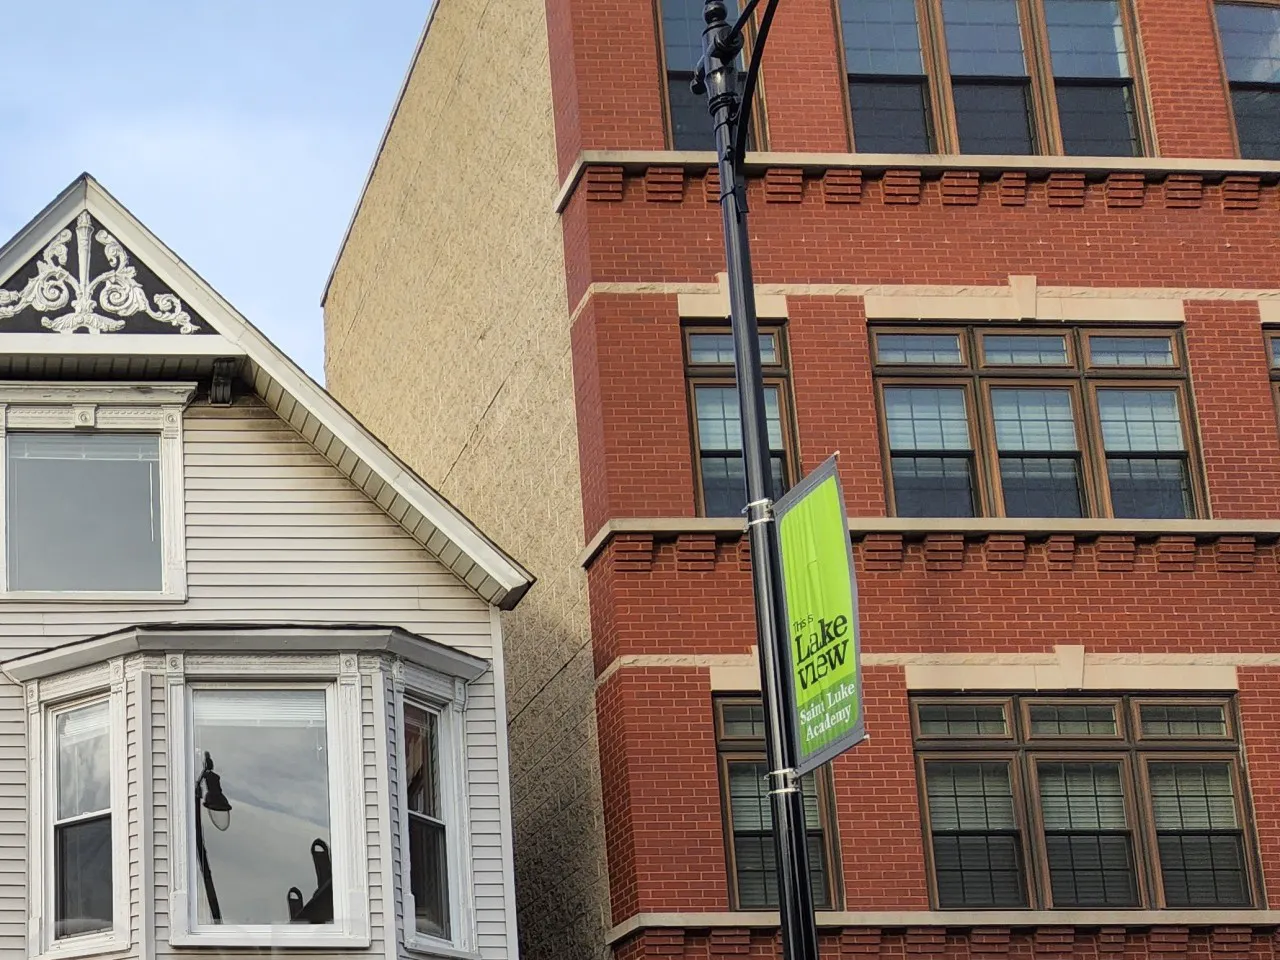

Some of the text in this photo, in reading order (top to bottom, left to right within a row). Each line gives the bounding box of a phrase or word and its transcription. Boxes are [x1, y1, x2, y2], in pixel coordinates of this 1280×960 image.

[792, 612, 814, 634] This is
[794, 614, 848, 666] Lake
[797, 638, 850, 690] view
[800, 683, 855, 725] Saint Luke
[805, 703, 852, 742] Academy
